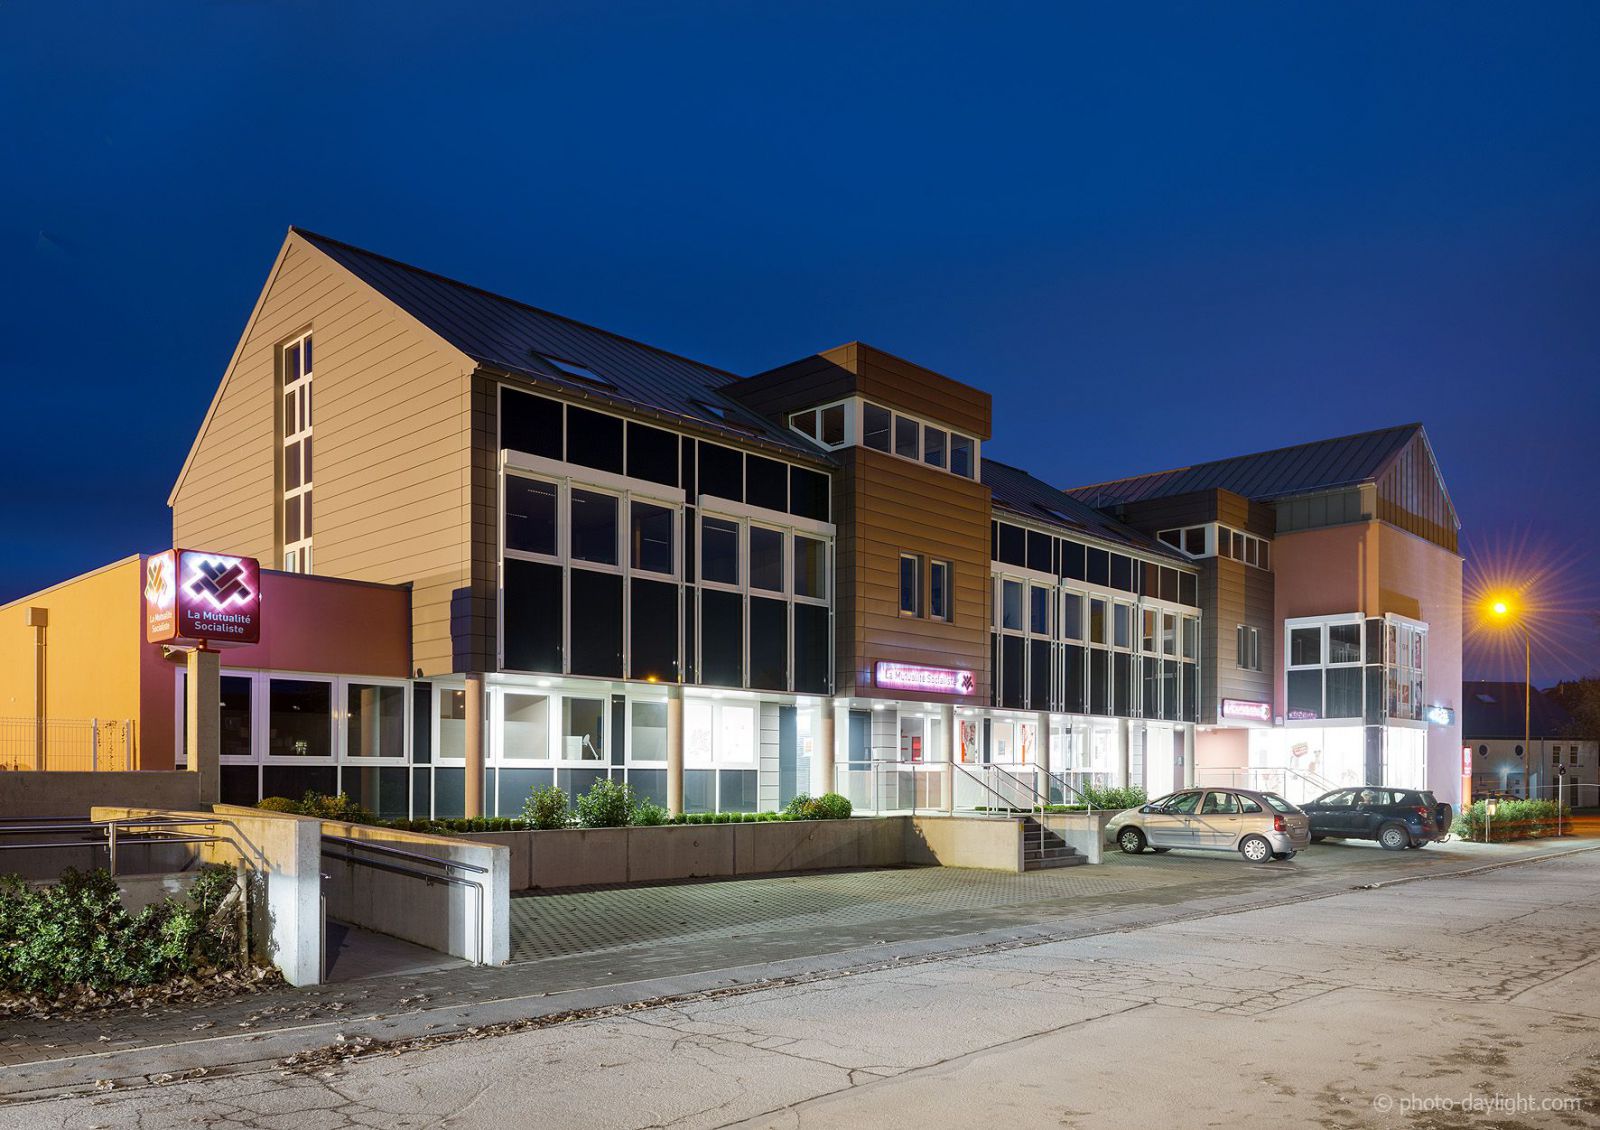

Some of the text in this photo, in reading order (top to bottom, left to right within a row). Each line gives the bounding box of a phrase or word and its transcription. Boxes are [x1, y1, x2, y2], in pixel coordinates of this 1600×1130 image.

[188, 610, 251, 624] La Mutualité
[194, 622, 244, 634] Socialiste
[885, 668, 893, 680] La
